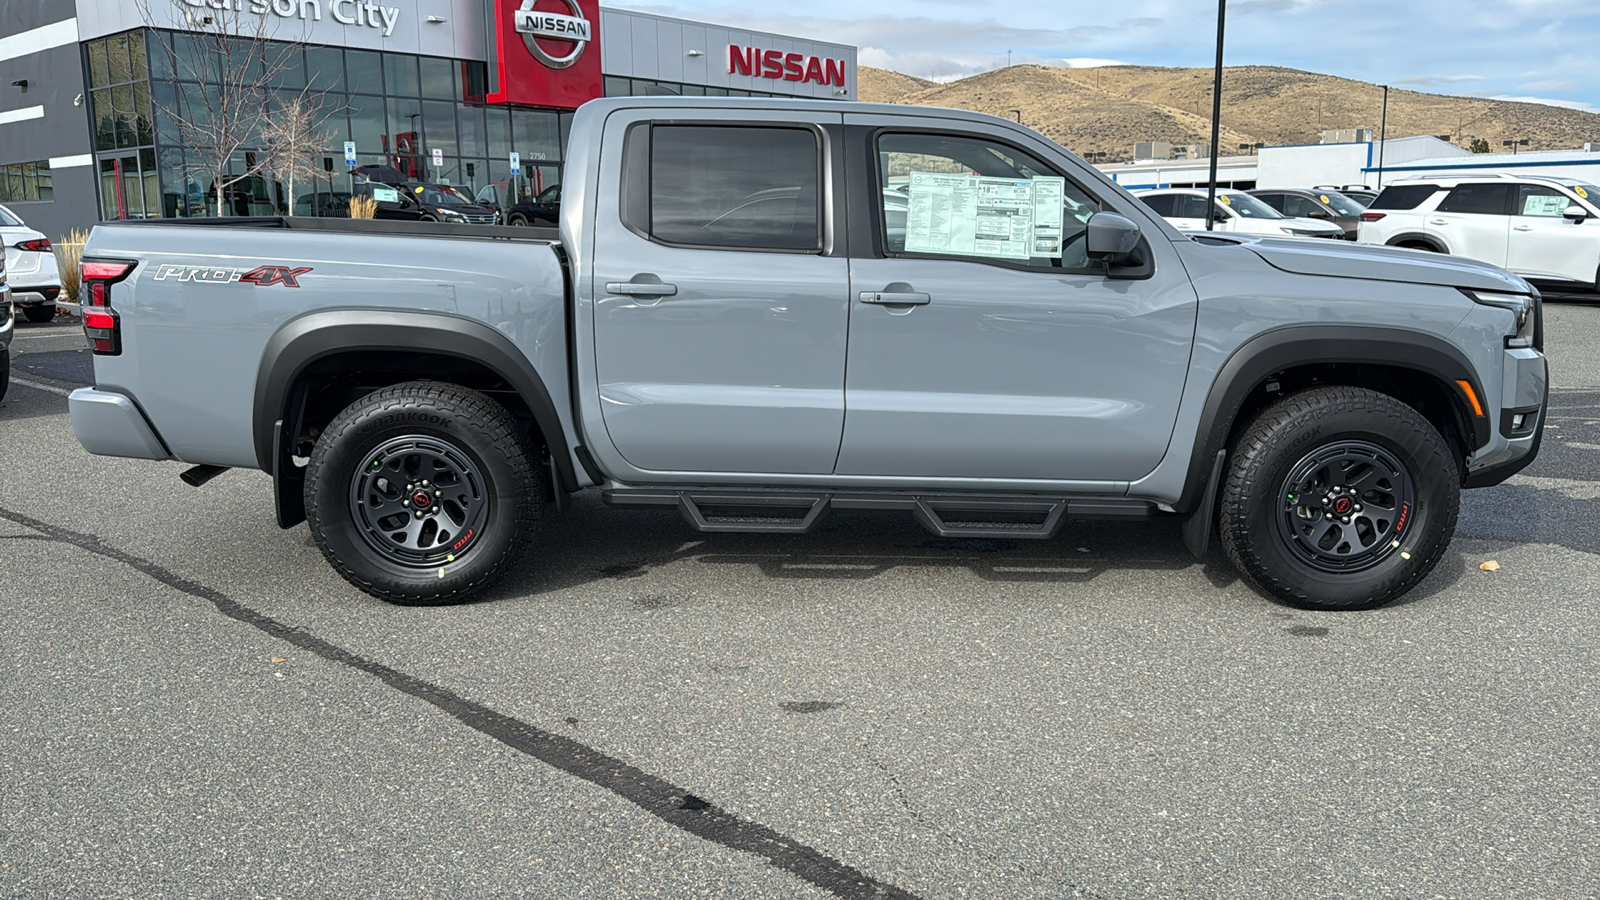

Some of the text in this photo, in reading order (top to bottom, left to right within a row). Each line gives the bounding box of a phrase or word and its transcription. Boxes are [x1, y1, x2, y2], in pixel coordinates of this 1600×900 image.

[331, 0, 399, 37] City
[525, 15, 587, 36] NISSAN
[728, 44, 845, 87] NISSAN
[530, 152, 546, 160] 2750
[1396, 505, 1408, 532] PRO
[454, 529, 473, 550] PRO
